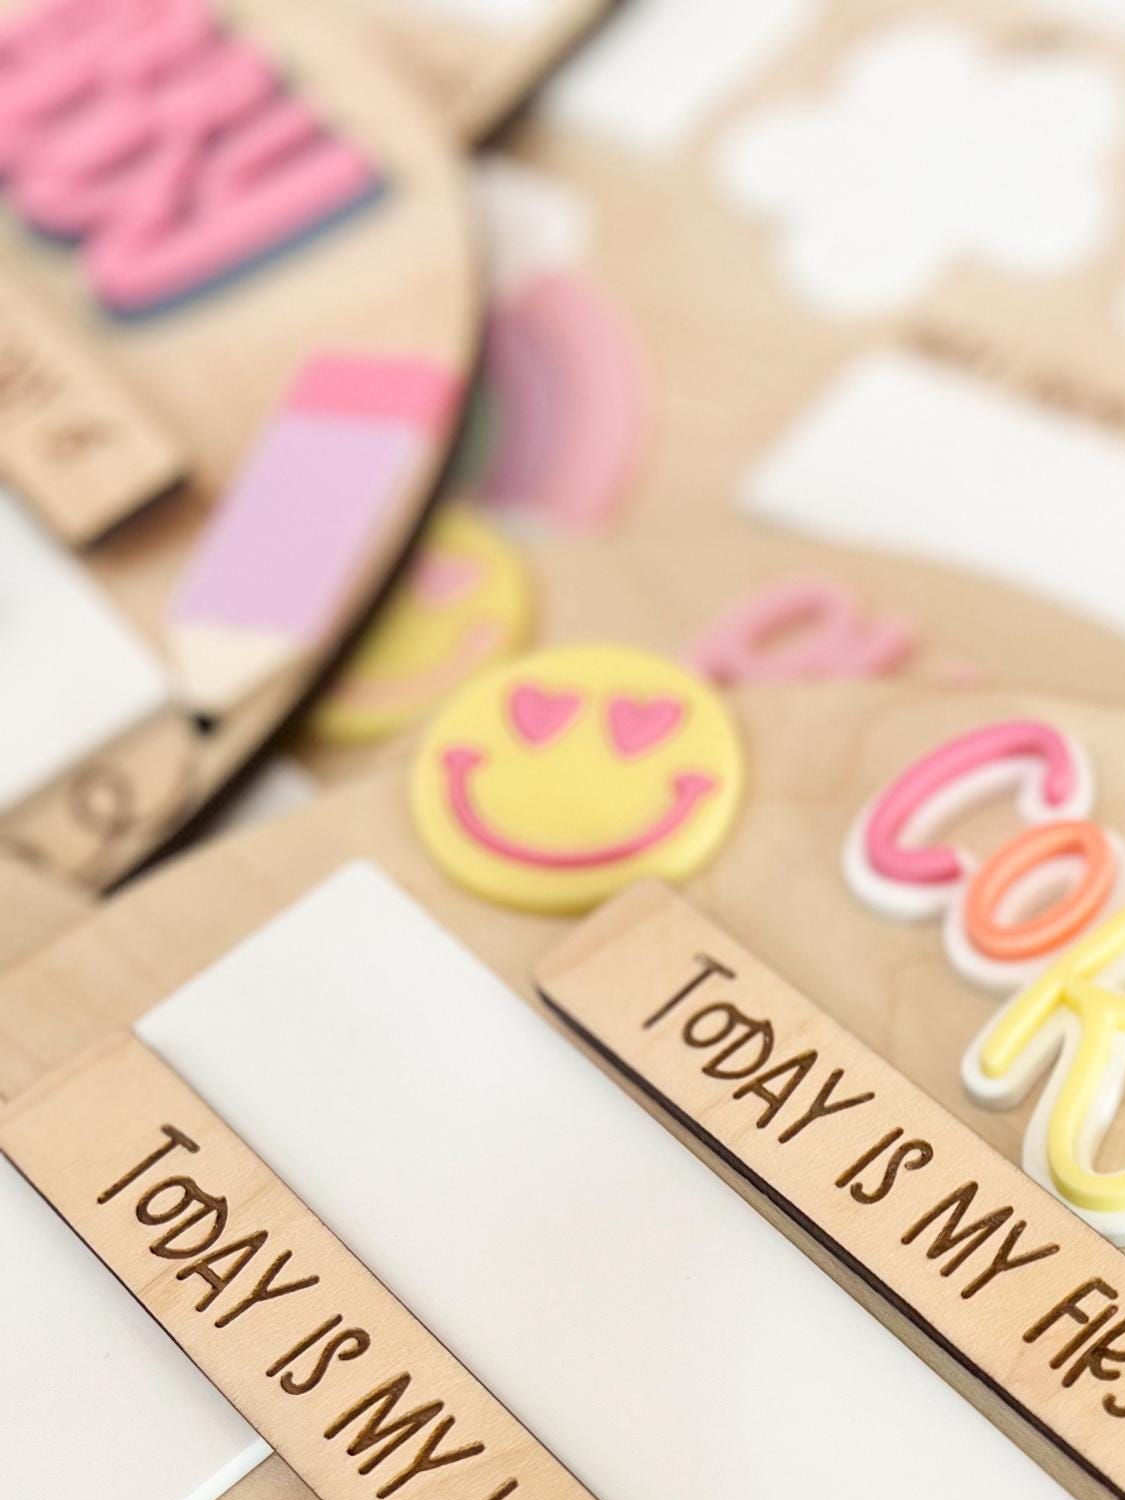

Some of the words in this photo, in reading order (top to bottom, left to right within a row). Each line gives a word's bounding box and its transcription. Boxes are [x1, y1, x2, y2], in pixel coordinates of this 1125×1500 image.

[834, 1126, 934, 1205] IS
[900, 1179, 1061, 1300] MY
[265, 1312, 372, 1397] IS
[323, 1371, 486, 1500] MY
